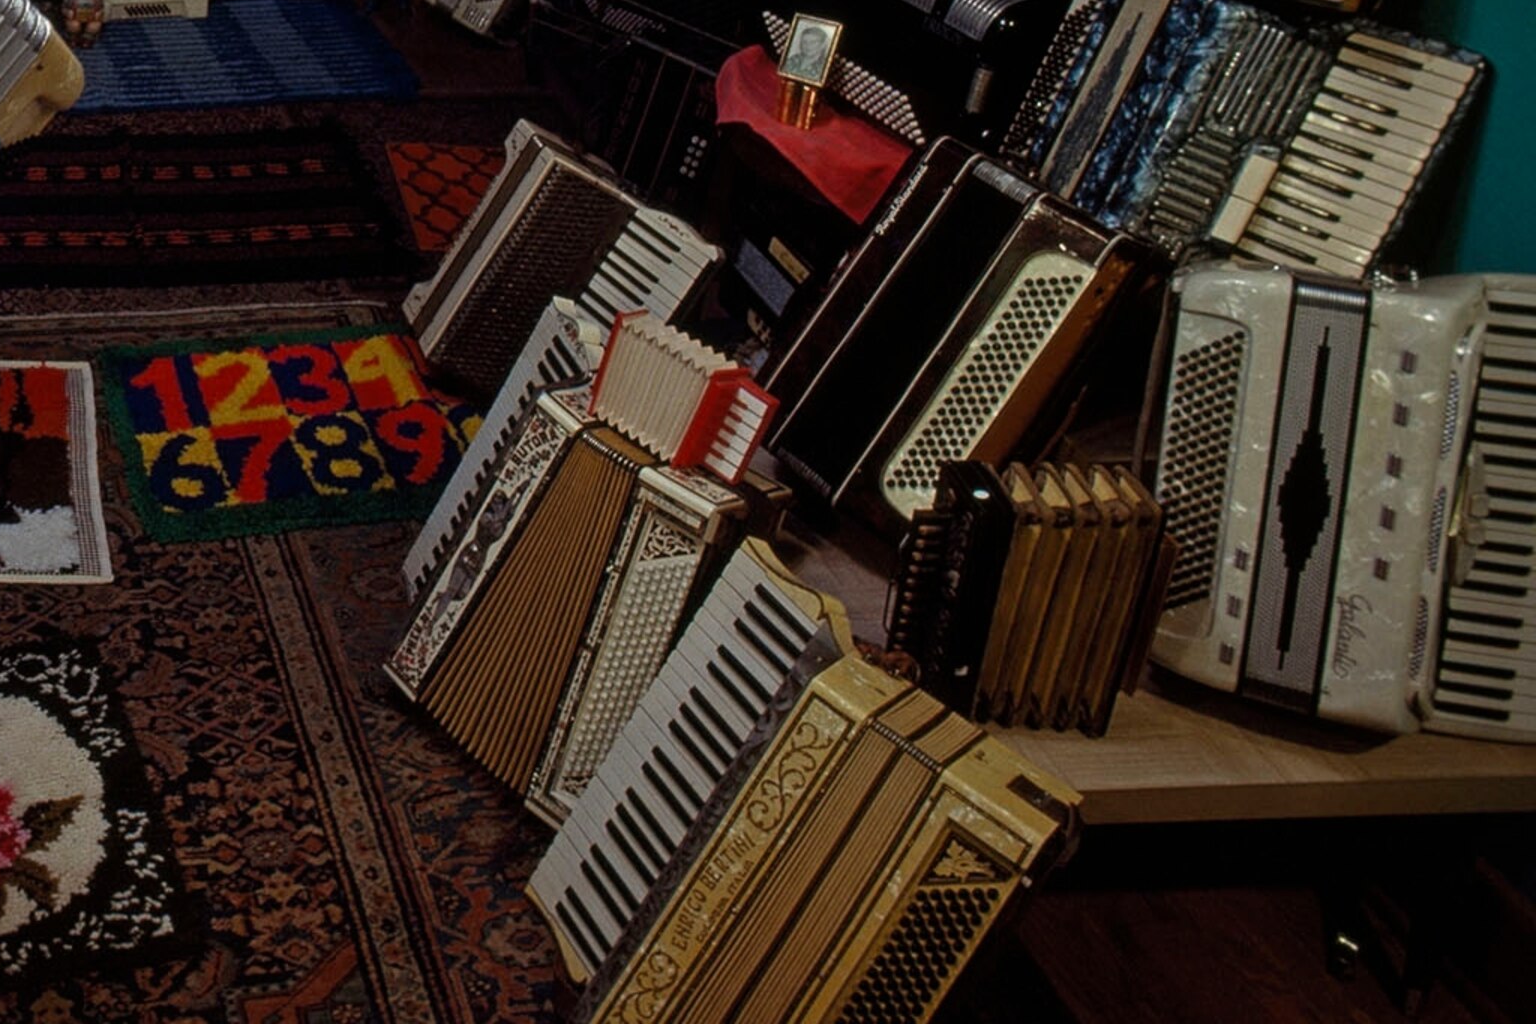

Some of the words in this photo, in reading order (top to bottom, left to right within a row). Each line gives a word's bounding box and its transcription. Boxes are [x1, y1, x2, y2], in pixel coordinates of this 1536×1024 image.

[130, 356, 193, 432] 1
[193, 350, 288, 426] 2
[267, 344, 351, 416] 3
[343, 334, 420, 407] 4
[149, 434, 228, 511] 6
[210, 416, 293, 503] 7
[295, 414, 385, 490] 8
[377, 402, 447, 484] 9
[511, 425, 560, 466] BUTORA
[671, 889, 707, 952] ENRICO
